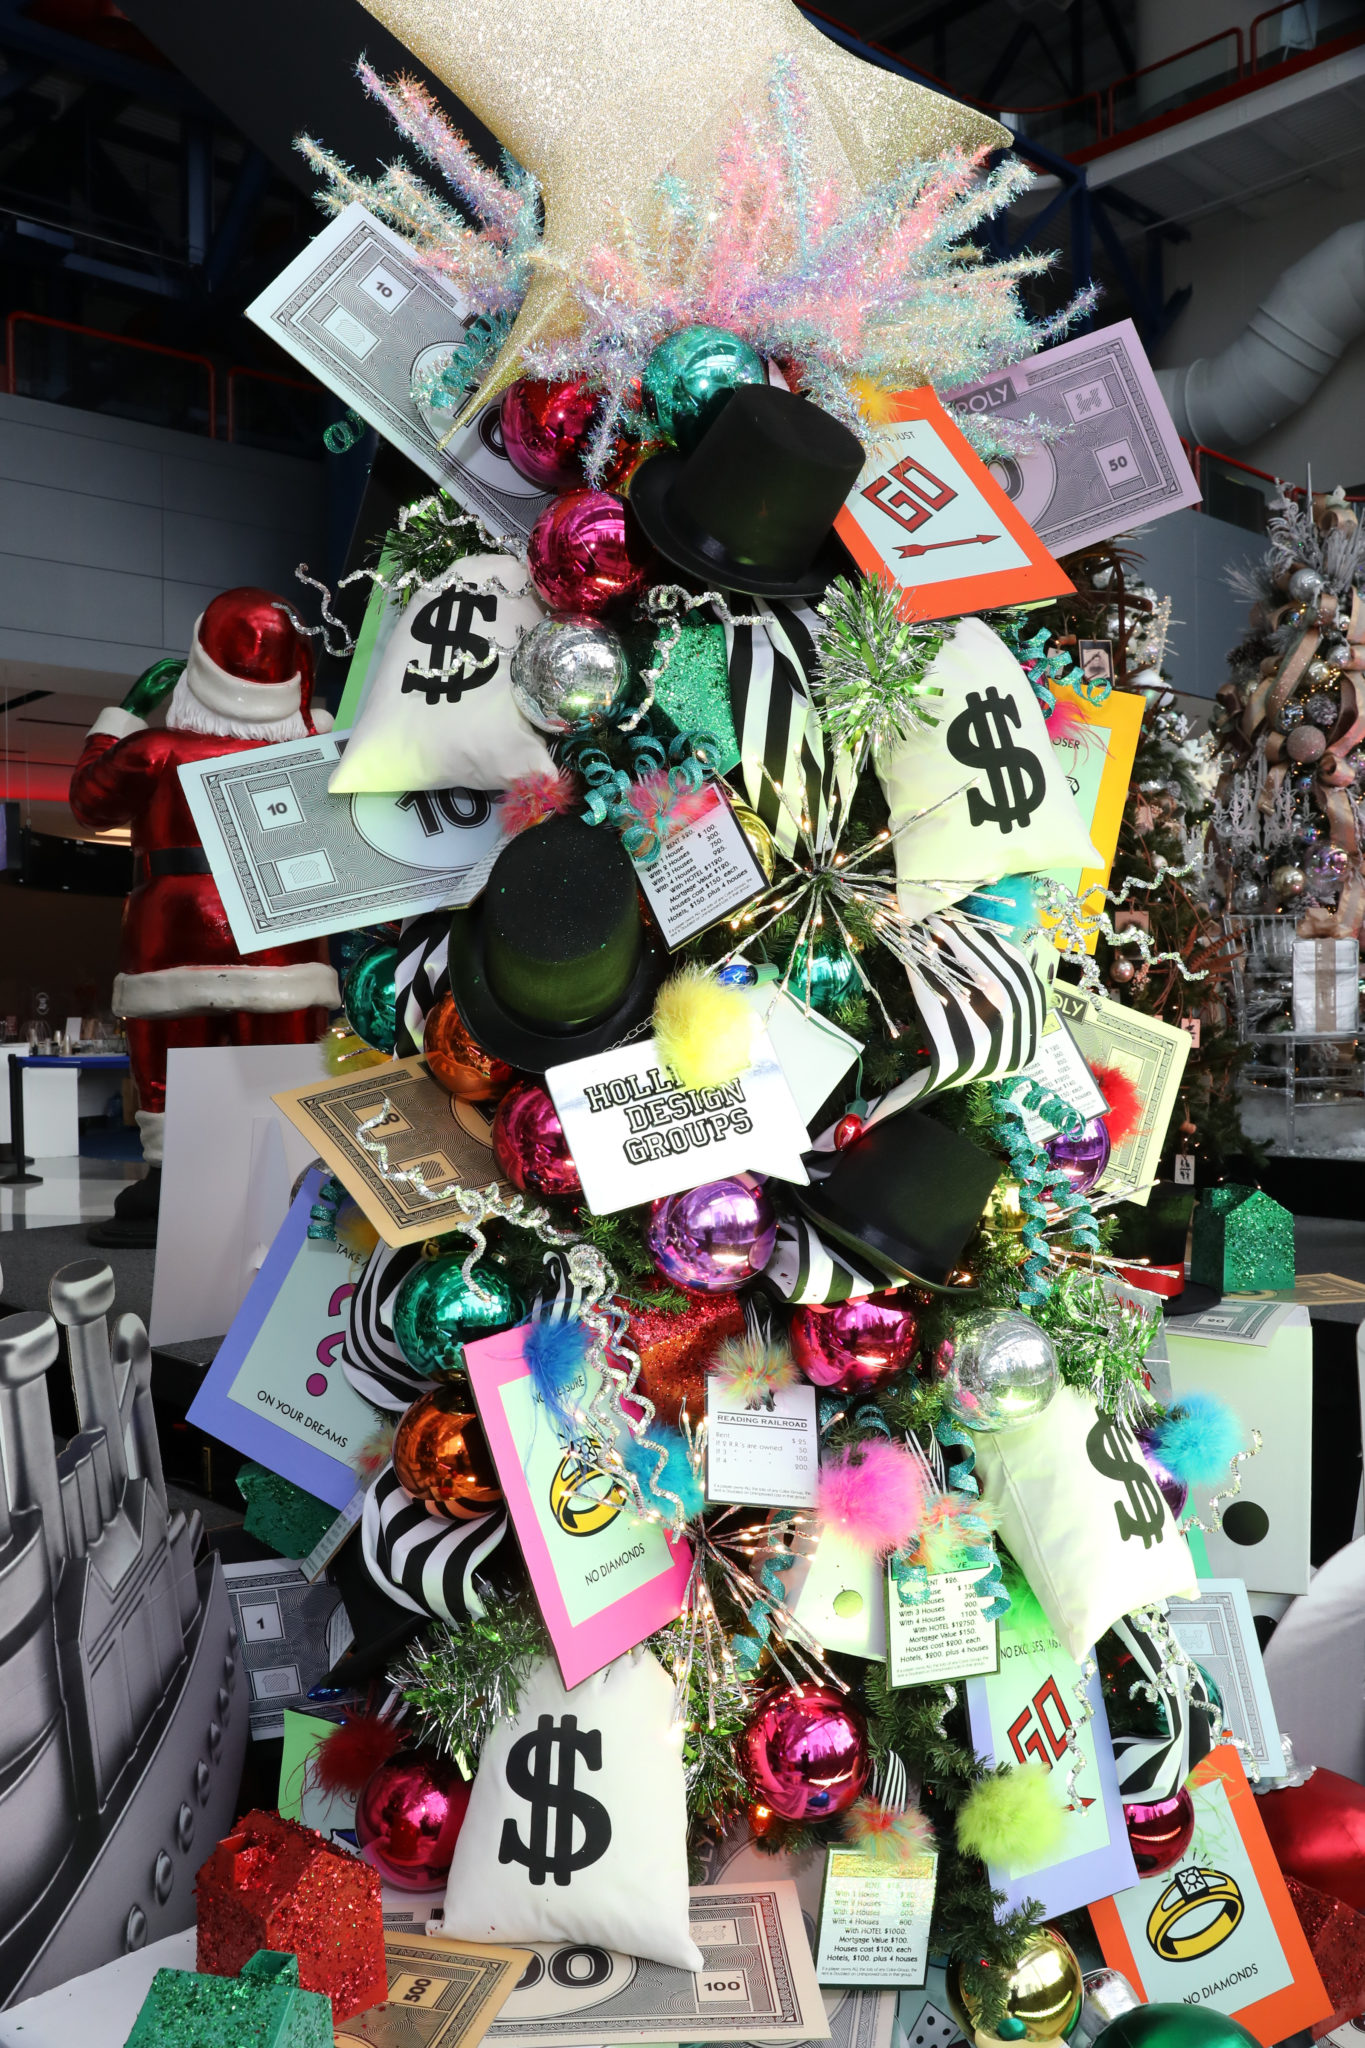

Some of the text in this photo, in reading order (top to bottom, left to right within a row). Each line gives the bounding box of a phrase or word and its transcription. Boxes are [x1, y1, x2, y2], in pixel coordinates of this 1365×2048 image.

[374, 280, 395, 298] 10
[956, 384, 1007, 412] POLY
[1109, 455, 1128, 472] 50
[860, 456, 959, 533] GO
[1051, 736, 1080, 750] OSER
[947, 686, 1046, 834] $
[267, 802, 288, 816] 10
[665, 846, 684, 860] House
[703, 824, 717, 835] 100.
[649, 869, 662, 880] With
[668, 851, 690, 868] Houses
[706, 832, 720, 842] 300.
[651, 876, 665, 887] With
[672, 858, 693, 874] Houses
[710, 839, 723, 848] 750.
[655, 883, 669, 894] With
[675, 866, 697, 882] Houses
[669, 883, 684, 894] With
[684, 871, 703, 887] HOTEL
[669, 866, 738, 913] Houses cost $150. each
[670, 882, 698, 904] Mortgage
[699, 873, 714, 885] Value
[668, 909, 689, 924] Hotels,
[708, 887, 721, 899] plus
[726, 869, 748, 885] houses
[624, 1077, 746, 1134] DESIGN
[623, 1107, 753, 1165] GROUPS
[335, 1241, 364, 1266] TAKE
[257, 1390, 349, 1449] ON YOUR DREAMS
[717, 1415, 808, 1428] READING RAILROAD
[585, 1542, 645, 1587] NO DIAMONDS
[256, 1617, 266, 1630] 1
[899, 1610, 913, 1618] With
[922, 1606, 945, 1614] Houses
[922, 1615, 946, 1623] Houses
[909, 1634, 938, 1644] Mortgage
[913, 1626, 928, 1634] With
[929, 1623, 949, 1632] HOTEL
[900, 1654, 922, 1663] Hotels,
[946, 1648, 959, 1656] plus
[967, 1644, 988, 1652] houses
[906, 1645, 929, 1653] Houses
[966, 1636, 981, 1644] each
[1000, 1647, 1012, 1659] NO
[498, 1714, 612, 1886] $
[827, 1954, 850, 1962] Hotels,
[403, 1978, 432, 2003] 500
[703, 1978, 740, 1994] 100
[1201, 1963, 1259, 1999] DIAMONDS
